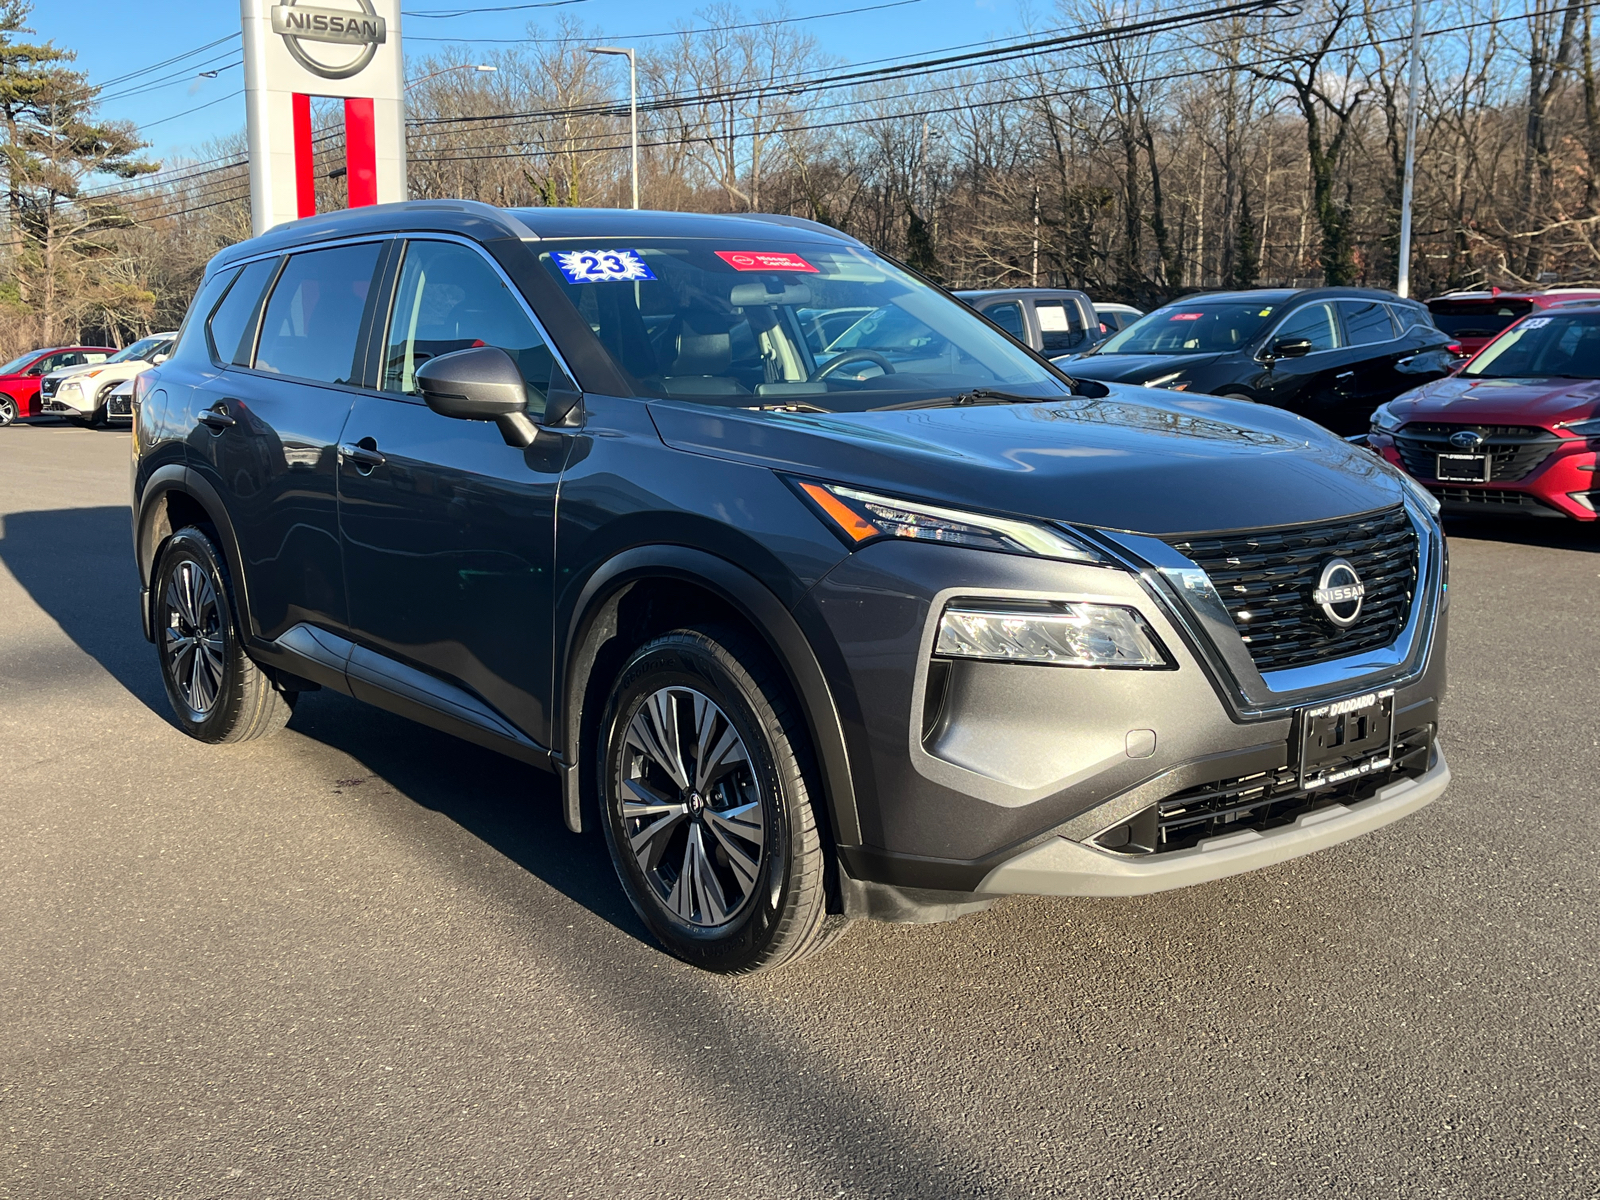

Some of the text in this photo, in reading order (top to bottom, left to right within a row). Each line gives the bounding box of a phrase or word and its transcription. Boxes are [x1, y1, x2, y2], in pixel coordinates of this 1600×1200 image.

[286, 12, 378, 36] NISSAN
[580, 255, 626, 275] 23
[763, 260, 805, 268] Certified
[1318, 584, 1365, 602] NISSAN
[1330, 693, 1376, 717] D'ADDARIO
